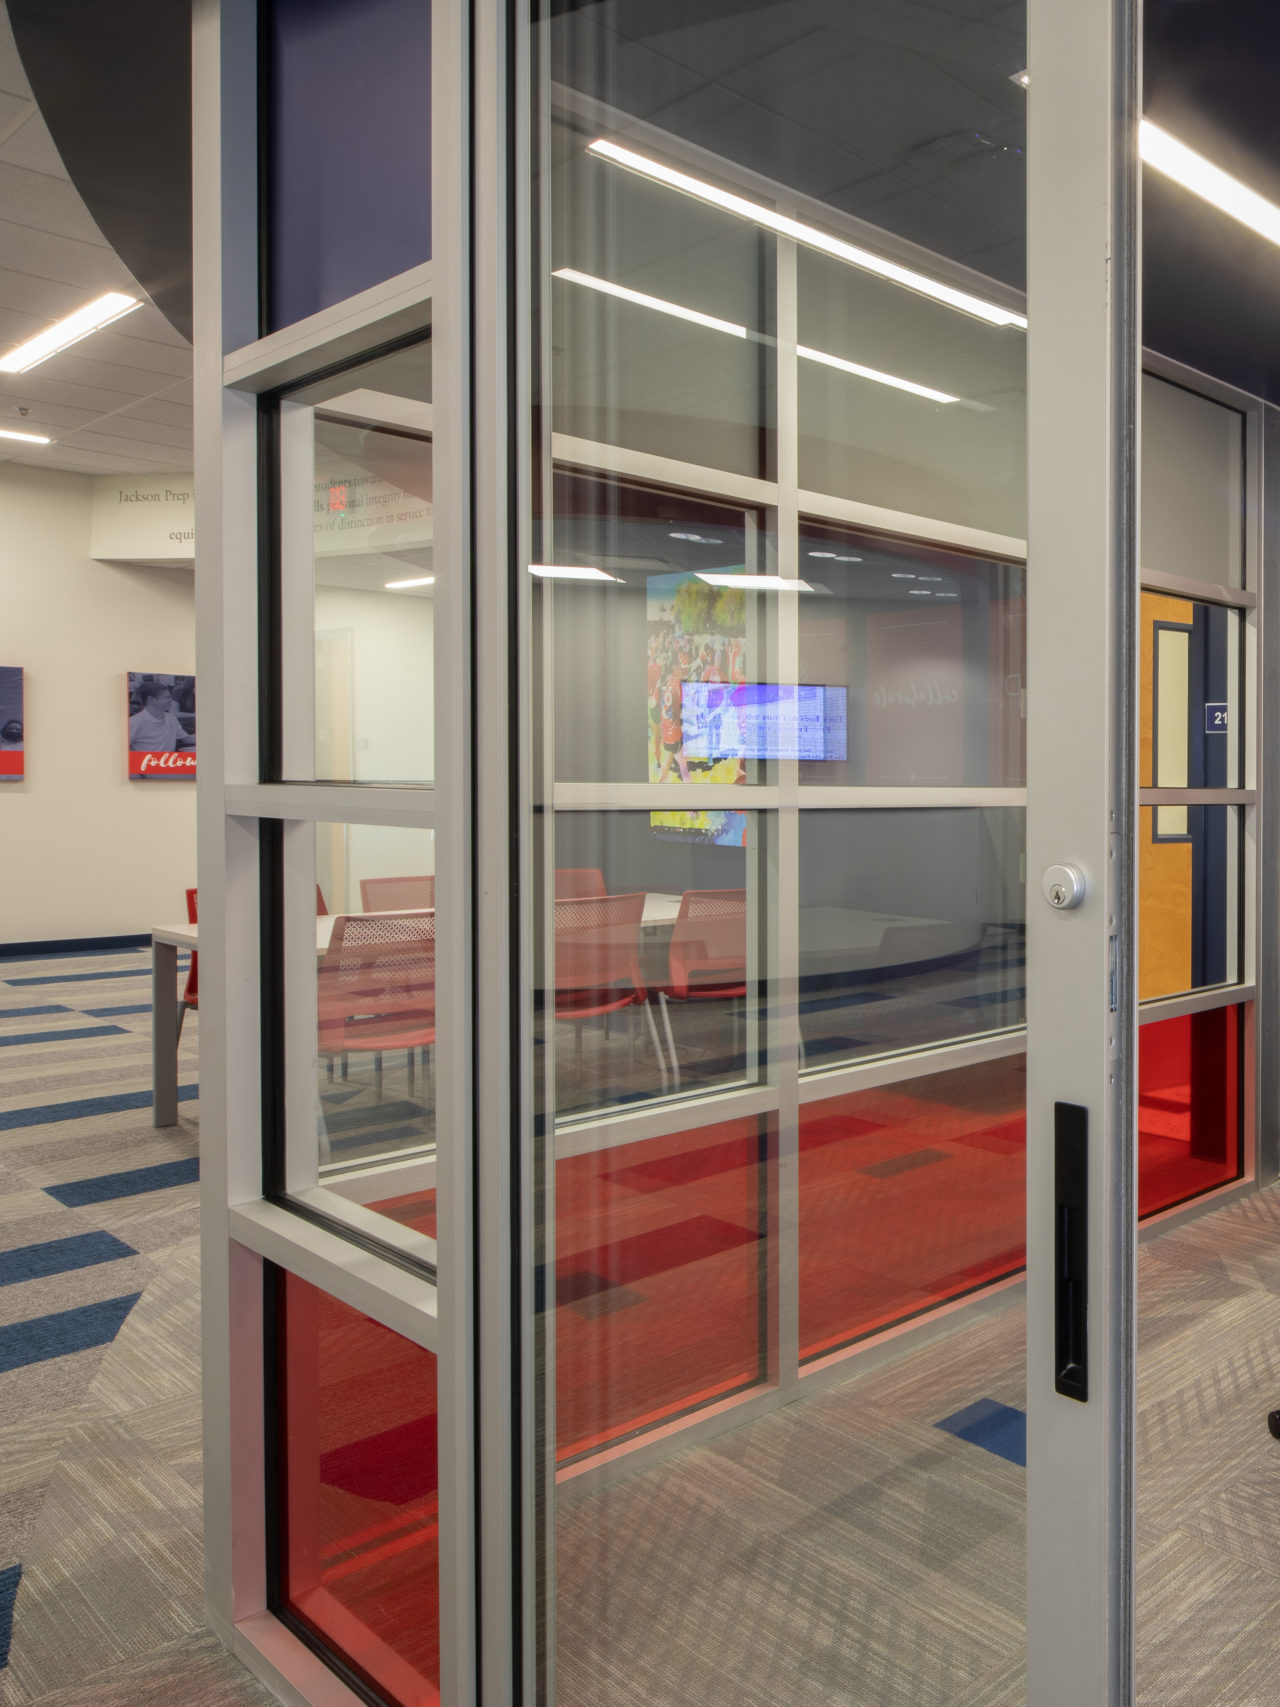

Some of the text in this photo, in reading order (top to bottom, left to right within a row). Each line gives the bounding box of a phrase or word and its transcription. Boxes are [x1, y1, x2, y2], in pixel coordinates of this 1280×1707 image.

[118, 489, 190, 505] Jackson Prep
[366, 491, 401, 507] integrity
[338, 513, 384, 530] distinction
[386, 511, 395, 522] in
[397, 507, 423, 521] service
[1214, 711, 1228, 725] 21
